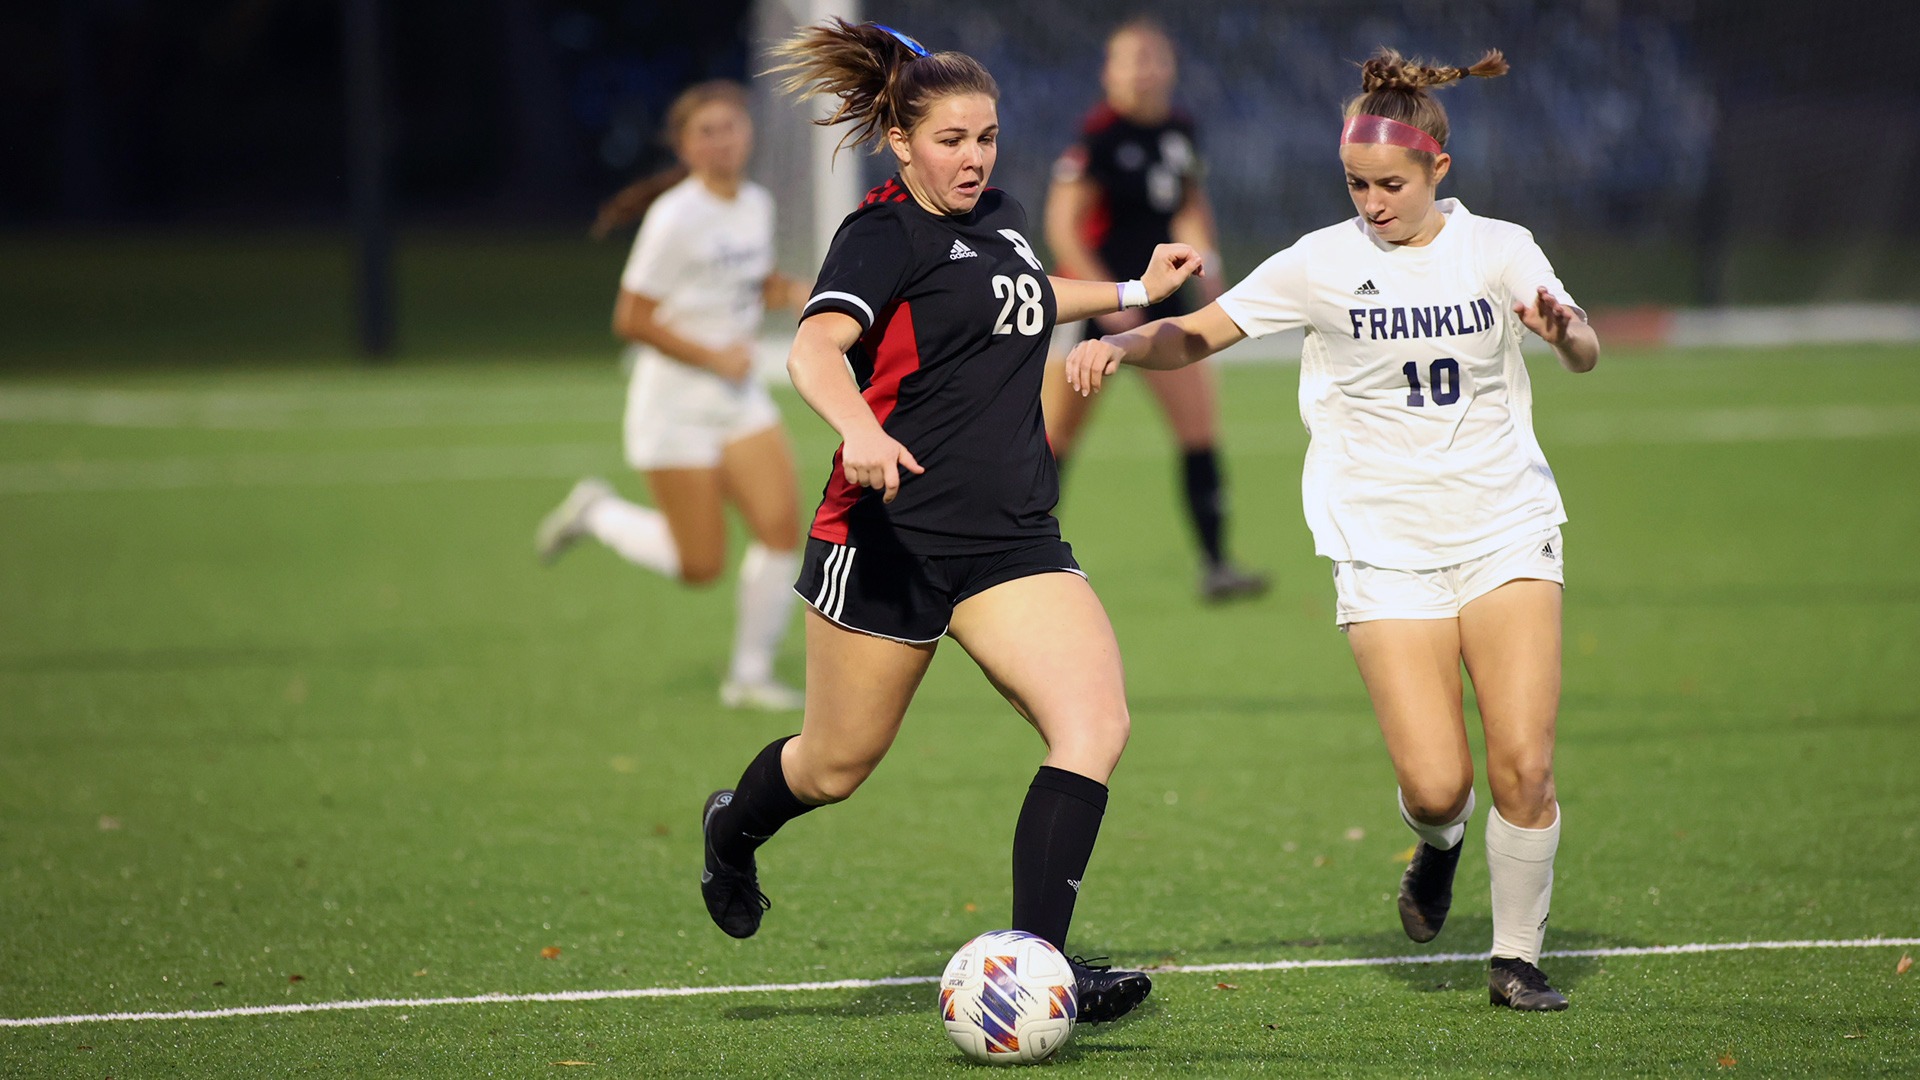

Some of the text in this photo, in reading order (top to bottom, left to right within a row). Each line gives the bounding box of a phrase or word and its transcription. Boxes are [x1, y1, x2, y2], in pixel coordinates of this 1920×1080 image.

[991, 273, 1044, 336] 28
[1349, 298, 1495, 340] FRANKLIN
[1402, 358, 1460, 407] 10
